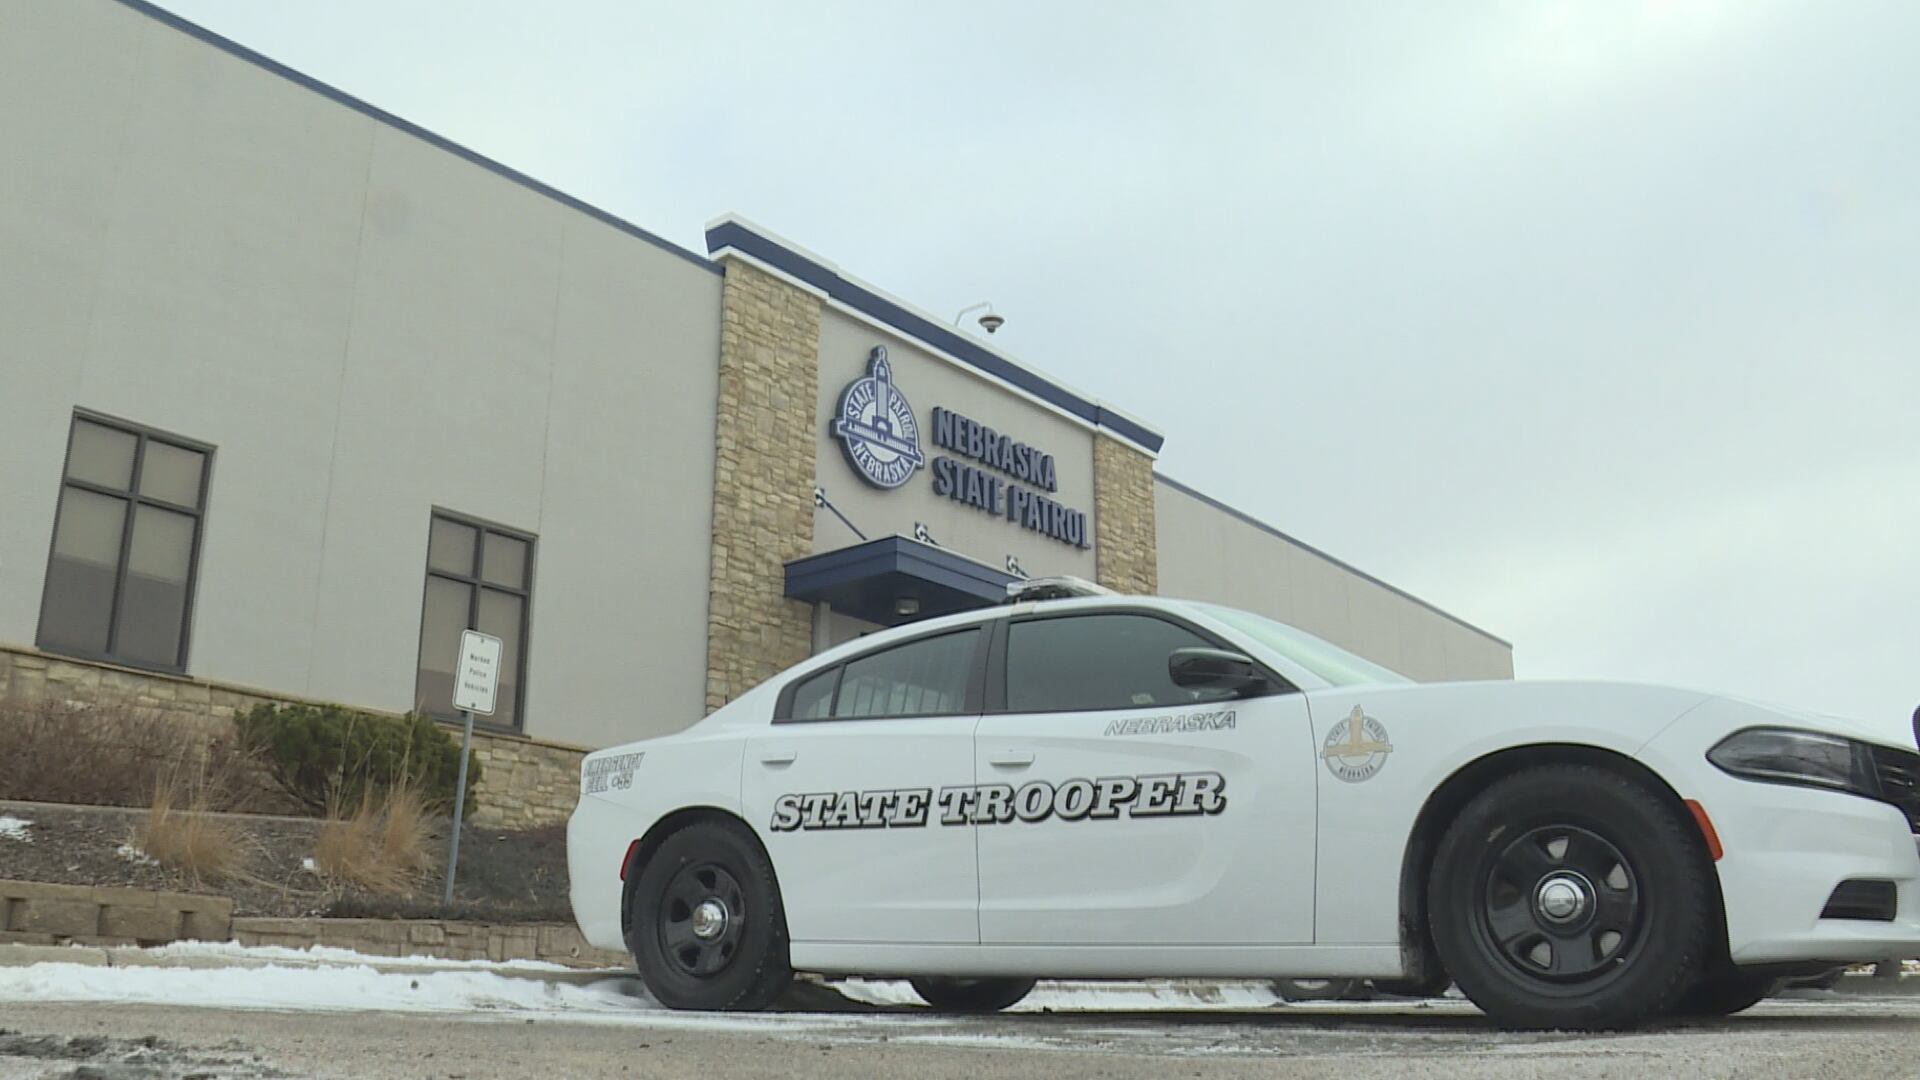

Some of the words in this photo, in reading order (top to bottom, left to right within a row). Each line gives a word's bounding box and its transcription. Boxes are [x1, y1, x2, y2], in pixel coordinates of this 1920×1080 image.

[847, 382, 875, 420] STATE
[888, 392, 916, 441] PATROL
[853, 441, 911, 481] NEBRASKA
[932, 406, 1058, 492] NEBRASKA
[932, 455, 1006, 517] STATE
[1007, 484, 1090, 550] PATROL
[1103, 710, 1237, 737] NEBRASKA
[770, 788, 932, 831] STATE
[939, 771, 1227, 825] TROOPER
